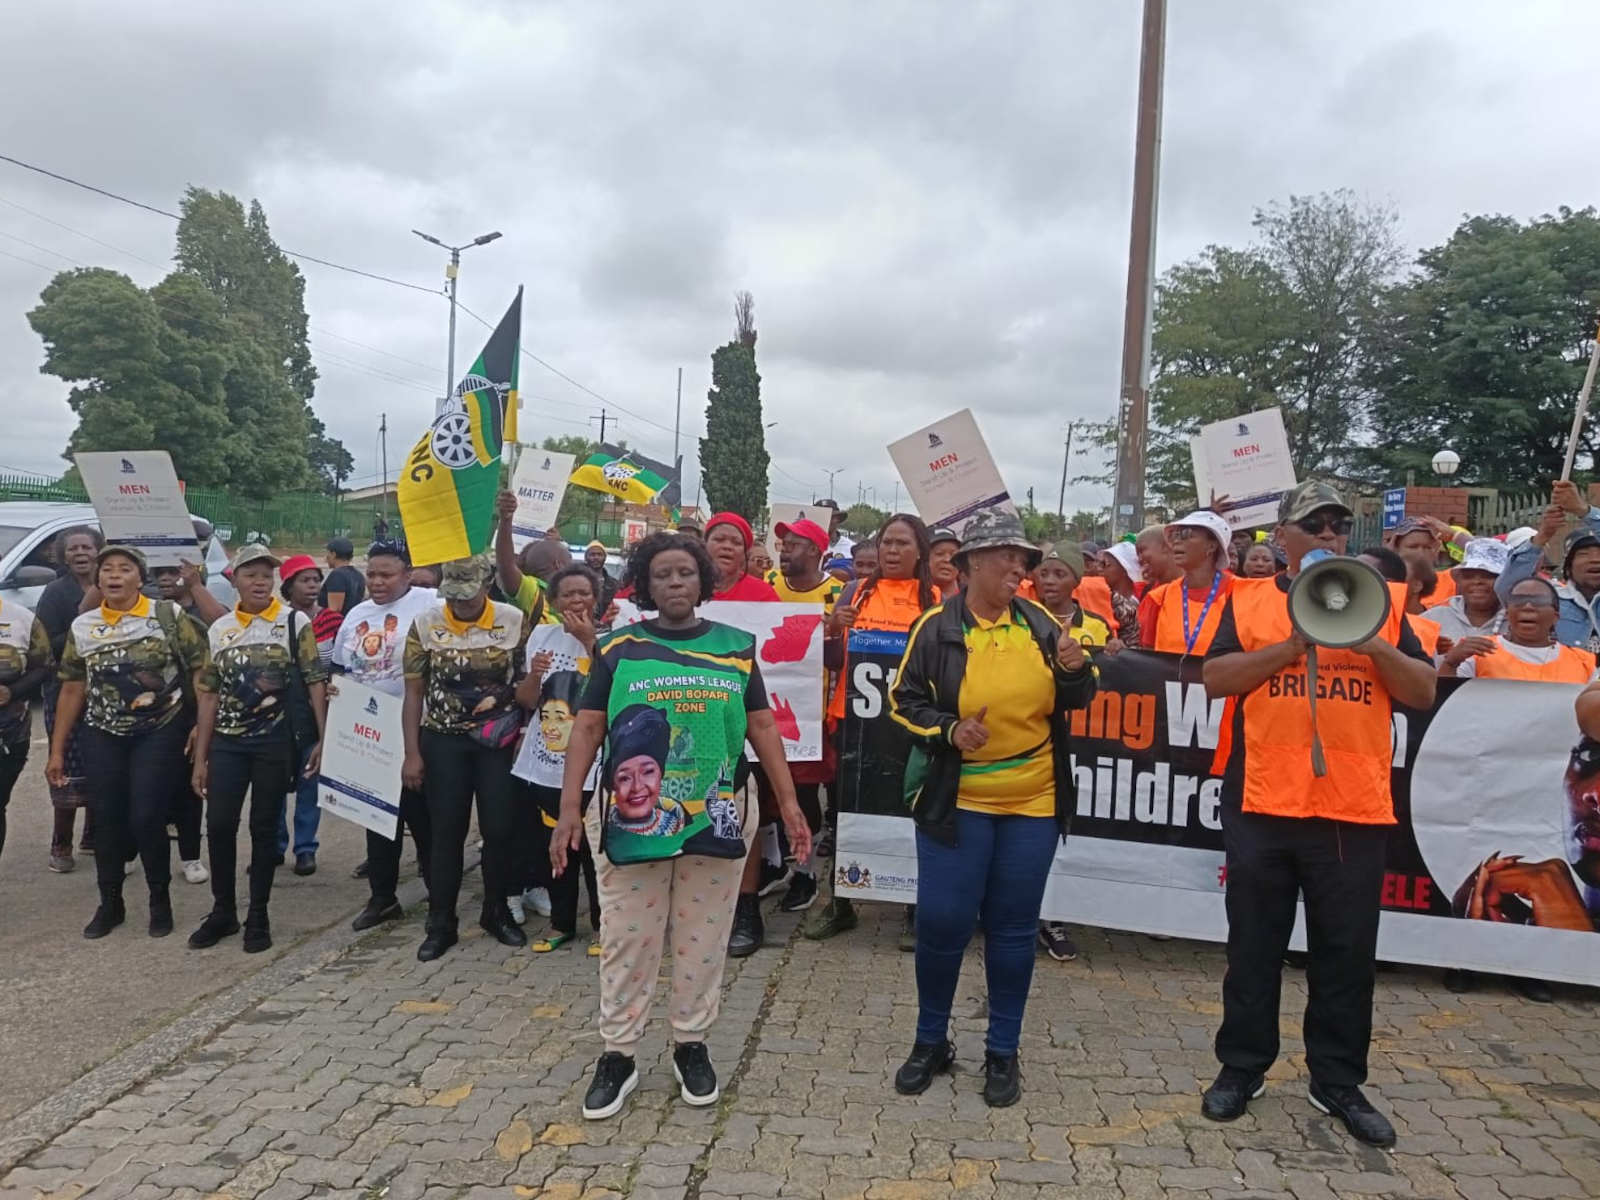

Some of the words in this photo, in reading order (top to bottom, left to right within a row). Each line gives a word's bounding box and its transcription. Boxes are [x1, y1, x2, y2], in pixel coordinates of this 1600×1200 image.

[1233, 444, 1260, 458] MEN
[929, 452, 958, 472] MEN
[118, 484, 151, 494] MEN
[518, 486, 555, 502] MATTER
[628, 679, 651, 693] ANC
[654, 675, 706, 687] WOMEN'S
[708, 677, 742, 694] LEAGUE
[1269, 673, 1373, 706] BRIGADE
[646, 690, 683, 702] DAVID
[686, 689, 729, 702] BOPAPE
[674, 702, 706, 713] ZONE
[1063, 689, 1157, 750] ing
[354, 722, 381, 742] MEN
[875, 874, 906, 884] GAUTENG
